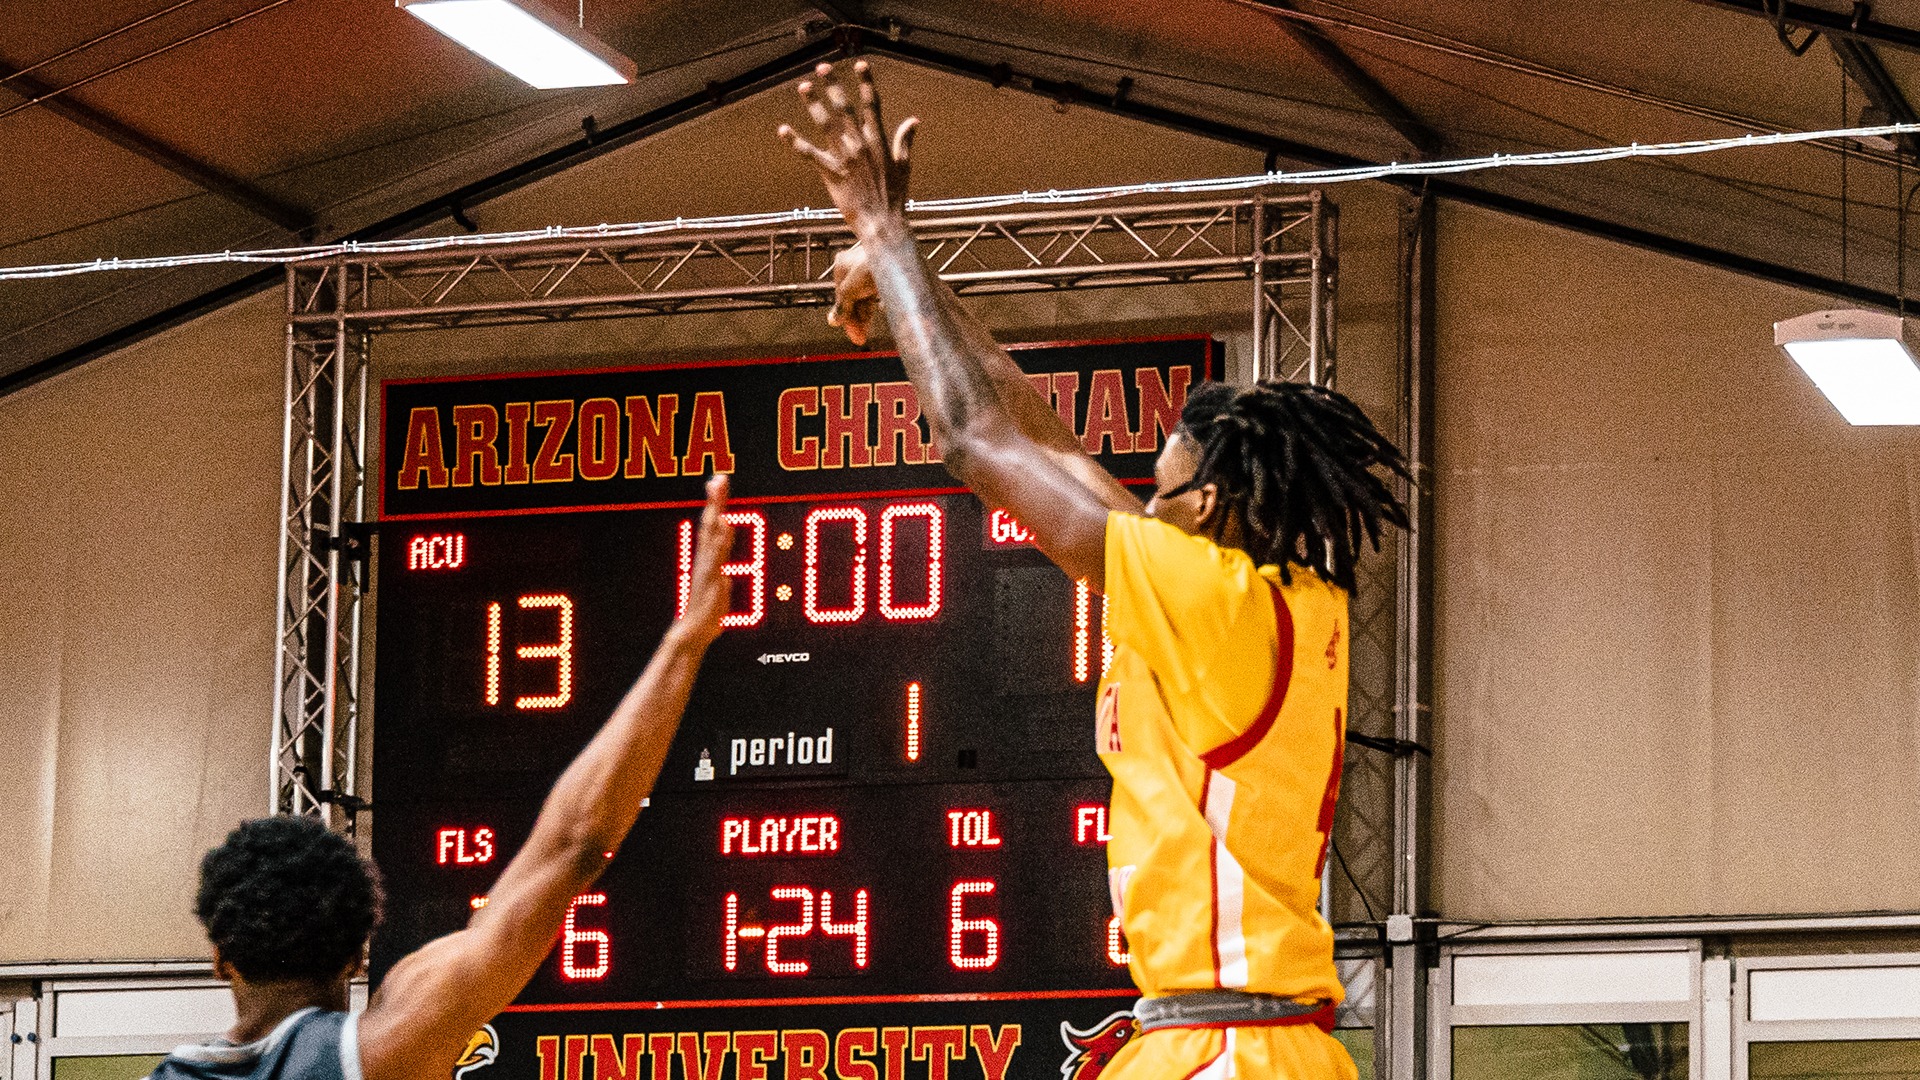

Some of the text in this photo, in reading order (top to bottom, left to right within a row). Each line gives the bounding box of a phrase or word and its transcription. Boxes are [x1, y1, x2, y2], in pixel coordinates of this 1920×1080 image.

[398, 365, 1192, 490] ARIZONA CHRIAN
[409, 535, 464, 570] ACU
[485, 594, 573, 709] 13
[730, 727, 833, 776] period
[438, 830, 493, 863] FLS
[723, 817, 837, 853] PLAYER
[948, 811, 1000, 846] TOL
[1078, 807, 1114, 842] FL
[563, 893, 609, 979] 6
[951, 882, 997, 968] 6
[536, 1024, 1022, 1080] UNIVERSITY
